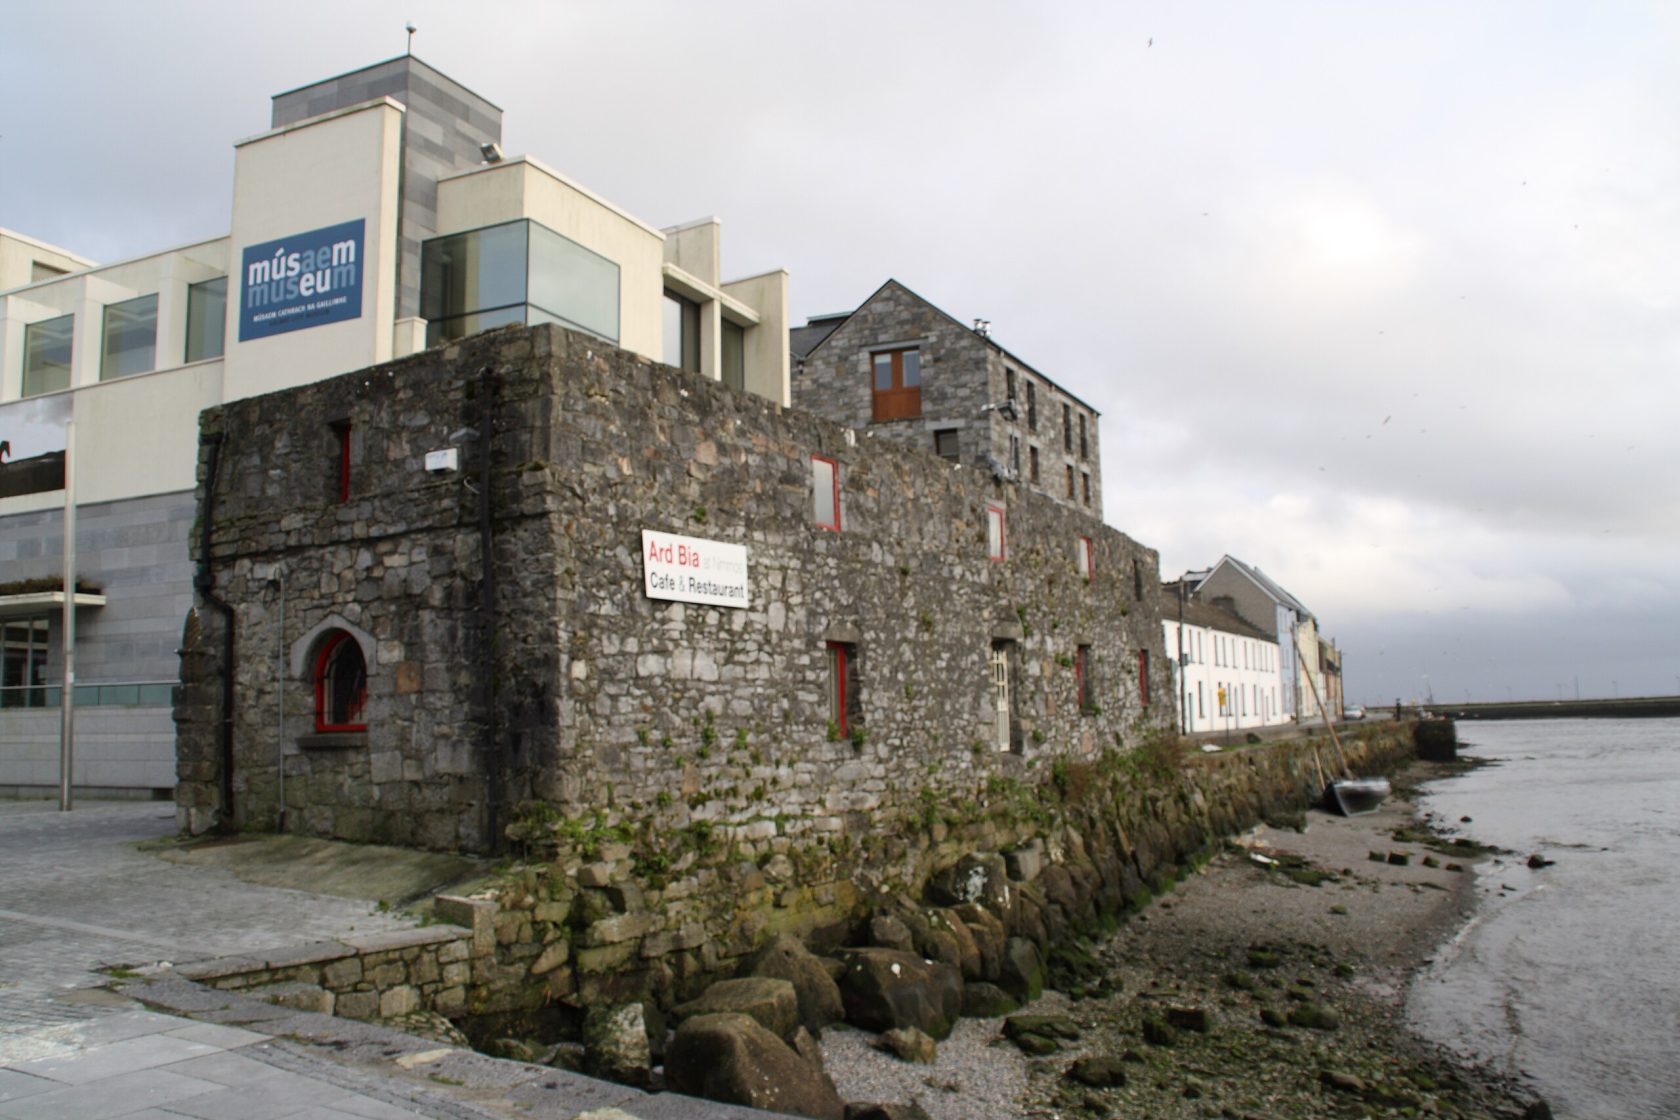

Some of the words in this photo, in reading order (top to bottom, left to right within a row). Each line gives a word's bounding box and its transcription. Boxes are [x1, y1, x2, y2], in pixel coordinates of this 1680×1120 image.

[248, 239, 355, 286] músaem
[247, 263, 355, 309] museum
[650, 540, 673, 564] Ard
[678, 544, 700, 567] Bia
[650, 571, 675, 591] Cafe
[679, 576, 685, 592] &
[688, 577, 745, 599] Restaurant
